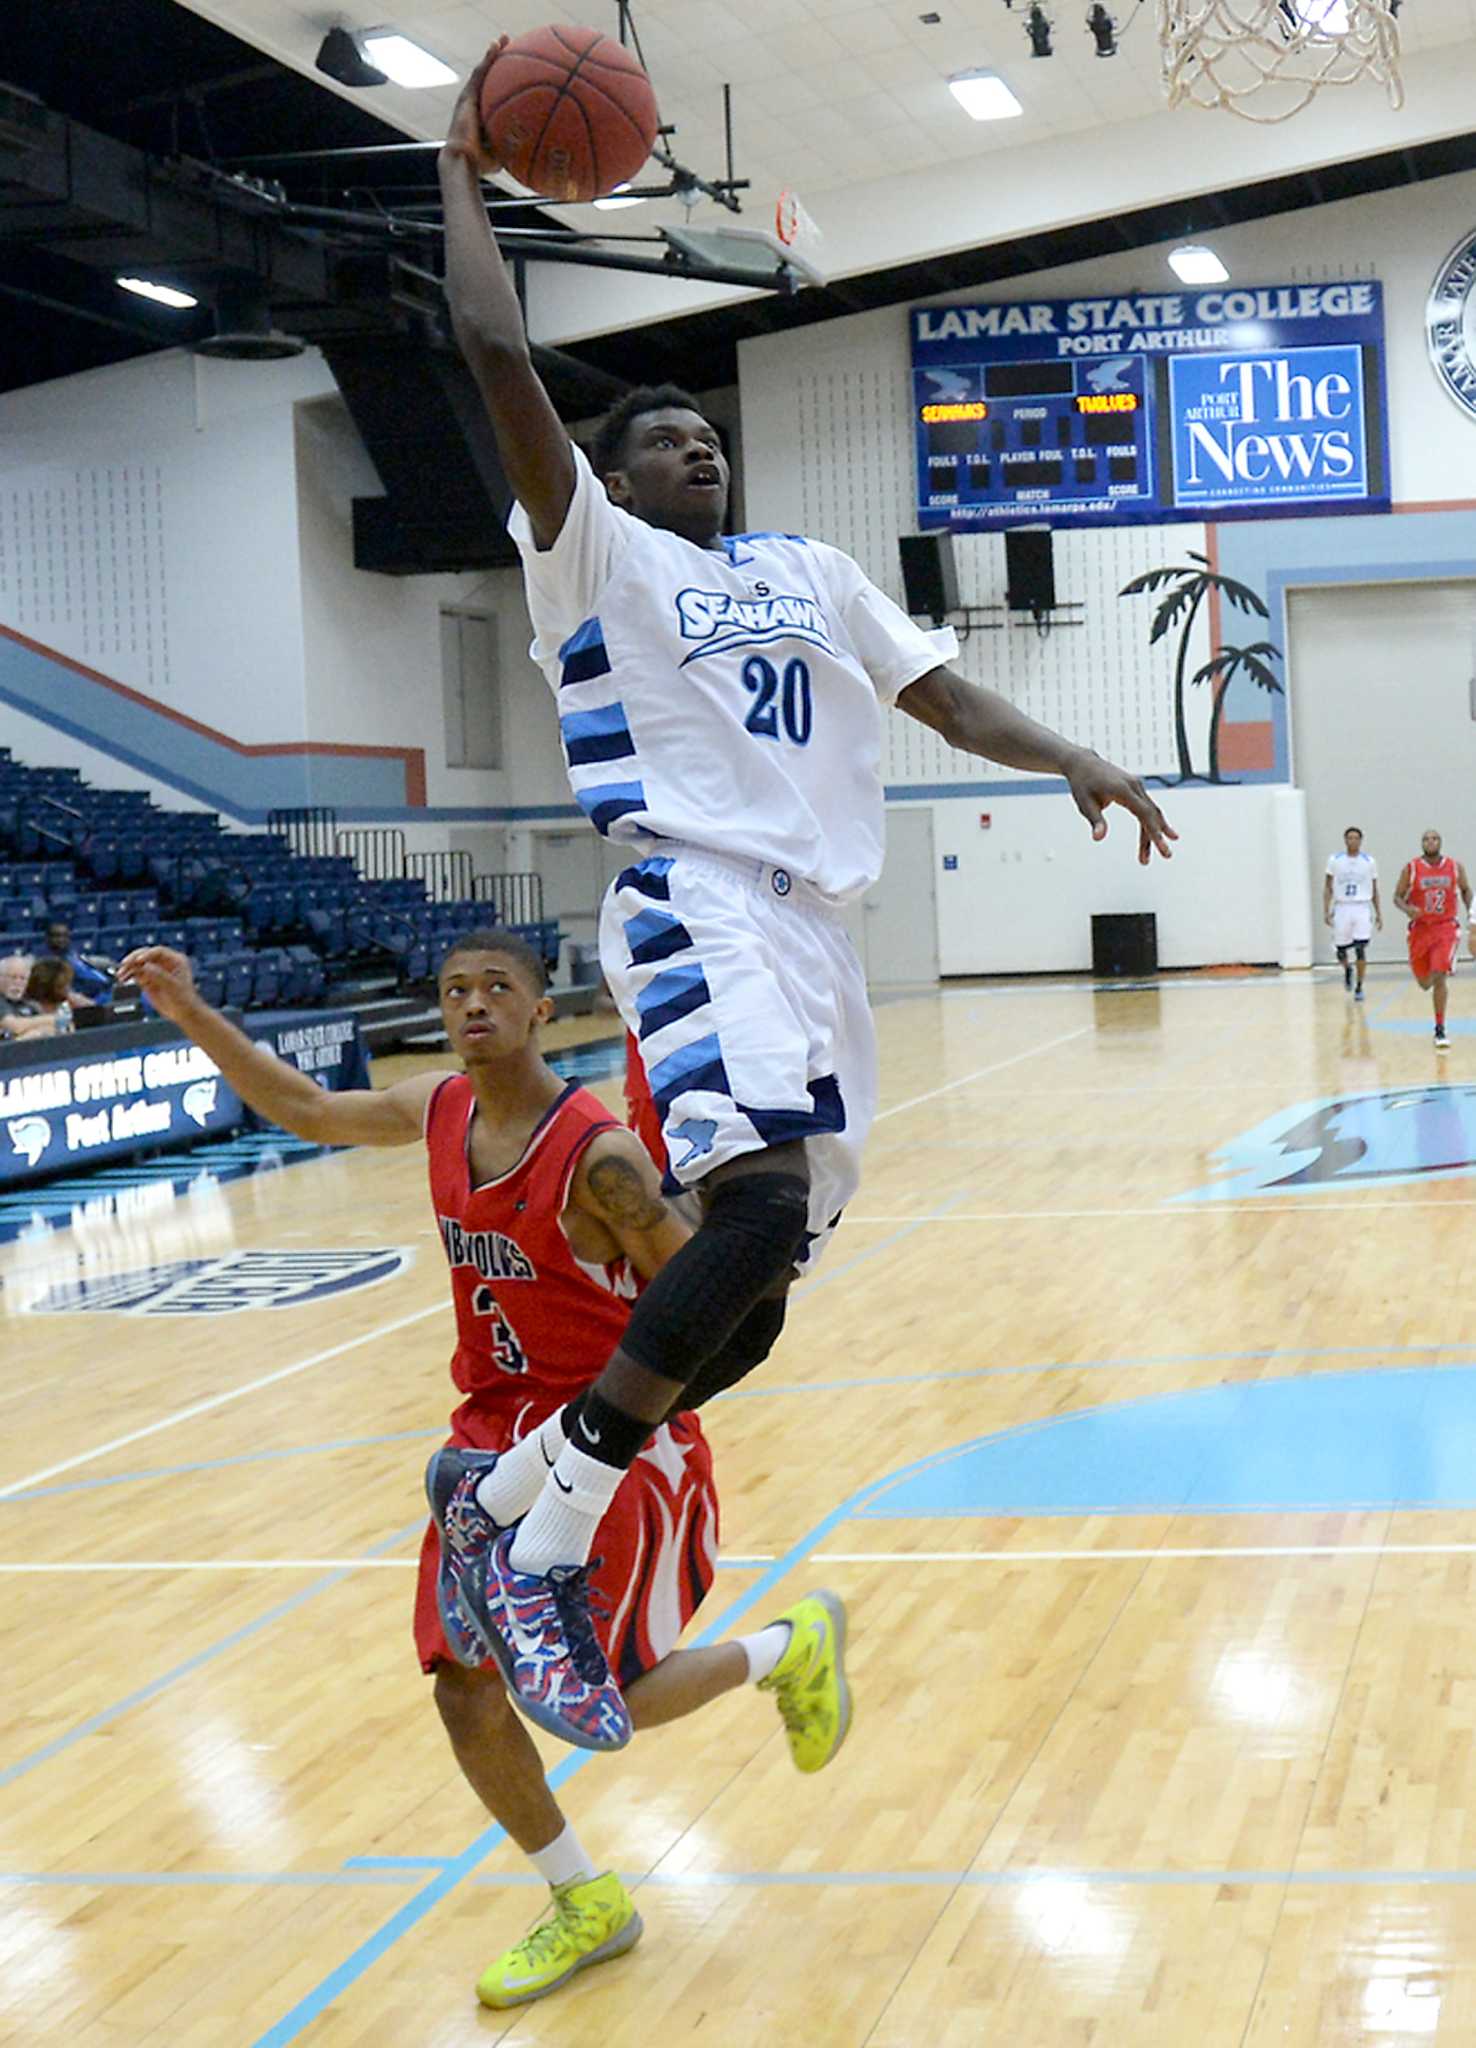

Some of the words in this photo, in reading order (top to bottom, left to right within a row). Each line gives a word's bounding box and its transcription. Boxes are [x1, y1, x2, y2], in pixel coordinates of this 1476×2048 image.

[917, 305, 1059, 341] LAMAR
[1067, 296, 1184, 332] STATE
[1196, 285, 1376, 322] COLLEGE
[1058, 333, 1123, 355] PORT
[1128, 327, 1229, 351] ARTHUR
[1201, 391, 1240, 406] PORT
[1220, 360, 1352, 423] The
[1013, 407, 1047, 419] PERIOD
[1184, 405, 1241, 420] ARTHUR
[928, 455, 958, 467] FOULS
[1000, 451, 1036, 463] PLAYER
[1039, 449, 1063, 461] FOUL
[1107, 446, 1137, 457] FOULS
[1184, 421, 1353, 483] News
[1016, 490, 1050, 500] MATCH
[1108, 485, 1139, 496] SCORE
[741, 655, 812, 746] 20
[1424, 889, 1446, 913] 12
[73, 1056, 143, 1103] STATE
[472, 1284, 529, 1375] 3
